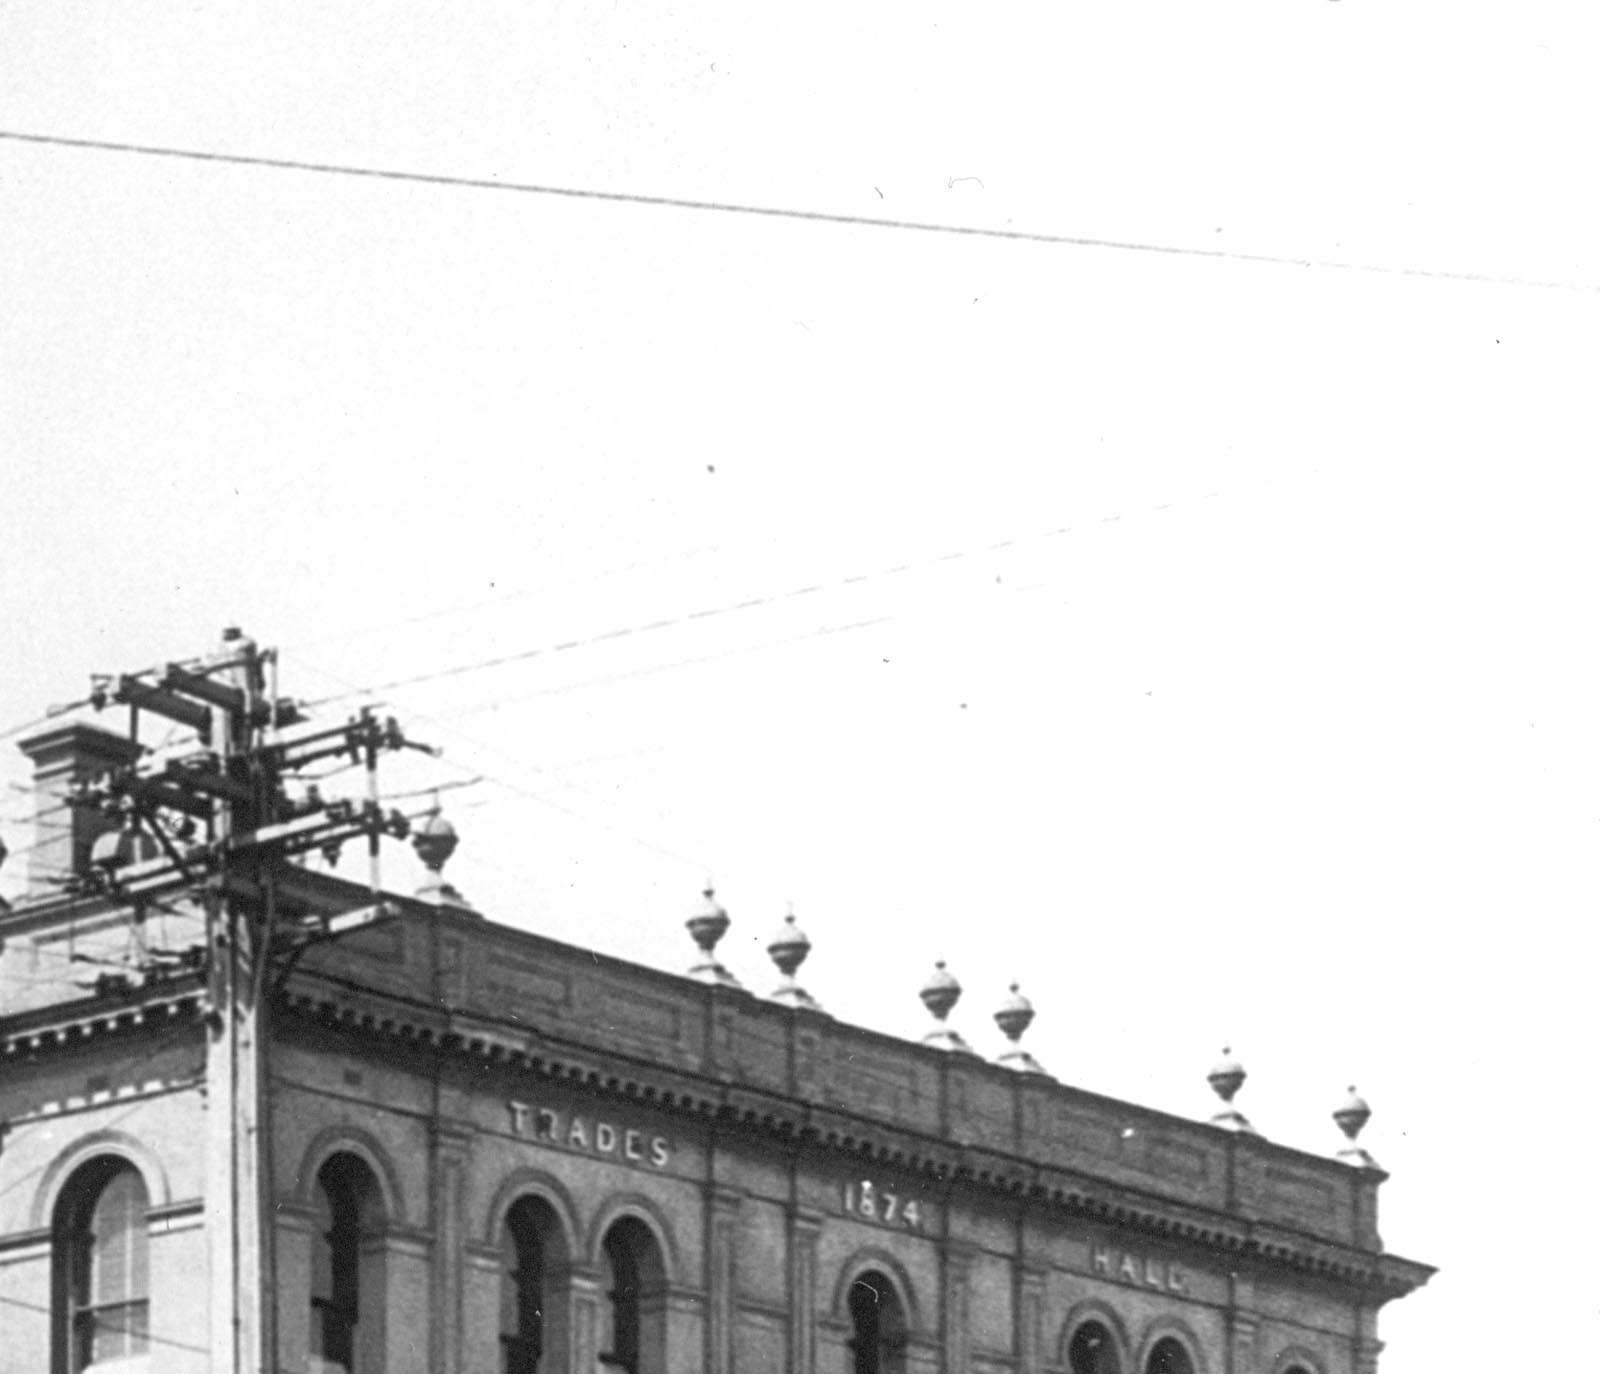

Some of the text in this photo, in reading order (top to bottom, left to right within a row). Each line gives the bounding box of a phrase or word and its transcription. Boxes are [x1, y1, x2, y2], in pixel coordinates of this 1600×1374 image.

[508, 1101, 671, 1168] TRADES
[843, 1181, 920, 1226] 1874
[1095, 1246, 1182, 1291] HALL
